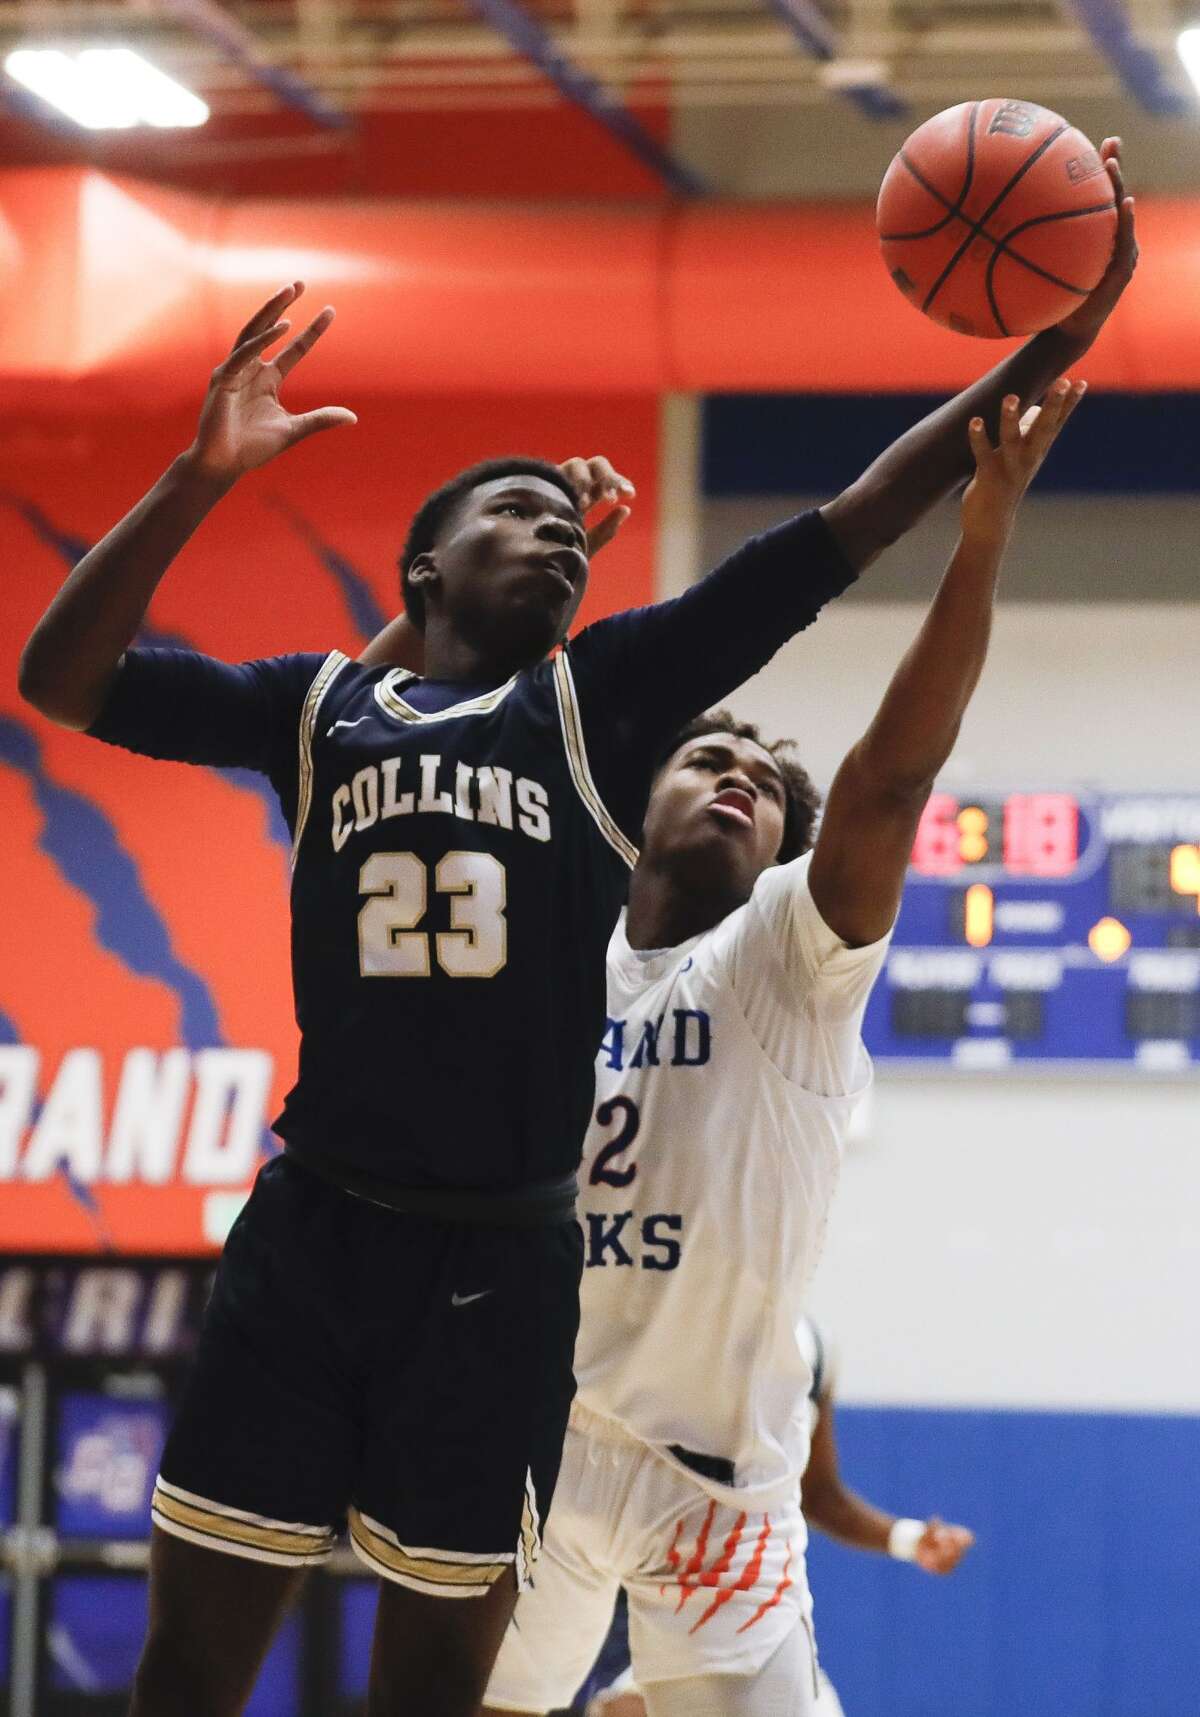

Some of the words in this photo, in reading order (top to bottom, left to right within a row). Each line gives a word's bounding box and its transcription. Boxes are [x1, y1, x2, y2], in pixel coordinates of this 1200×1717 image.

[331, 754, 552, 852] COLLINS
[357, 850, 508, 978] 23
[589, 1095, 641, 1188] 2
